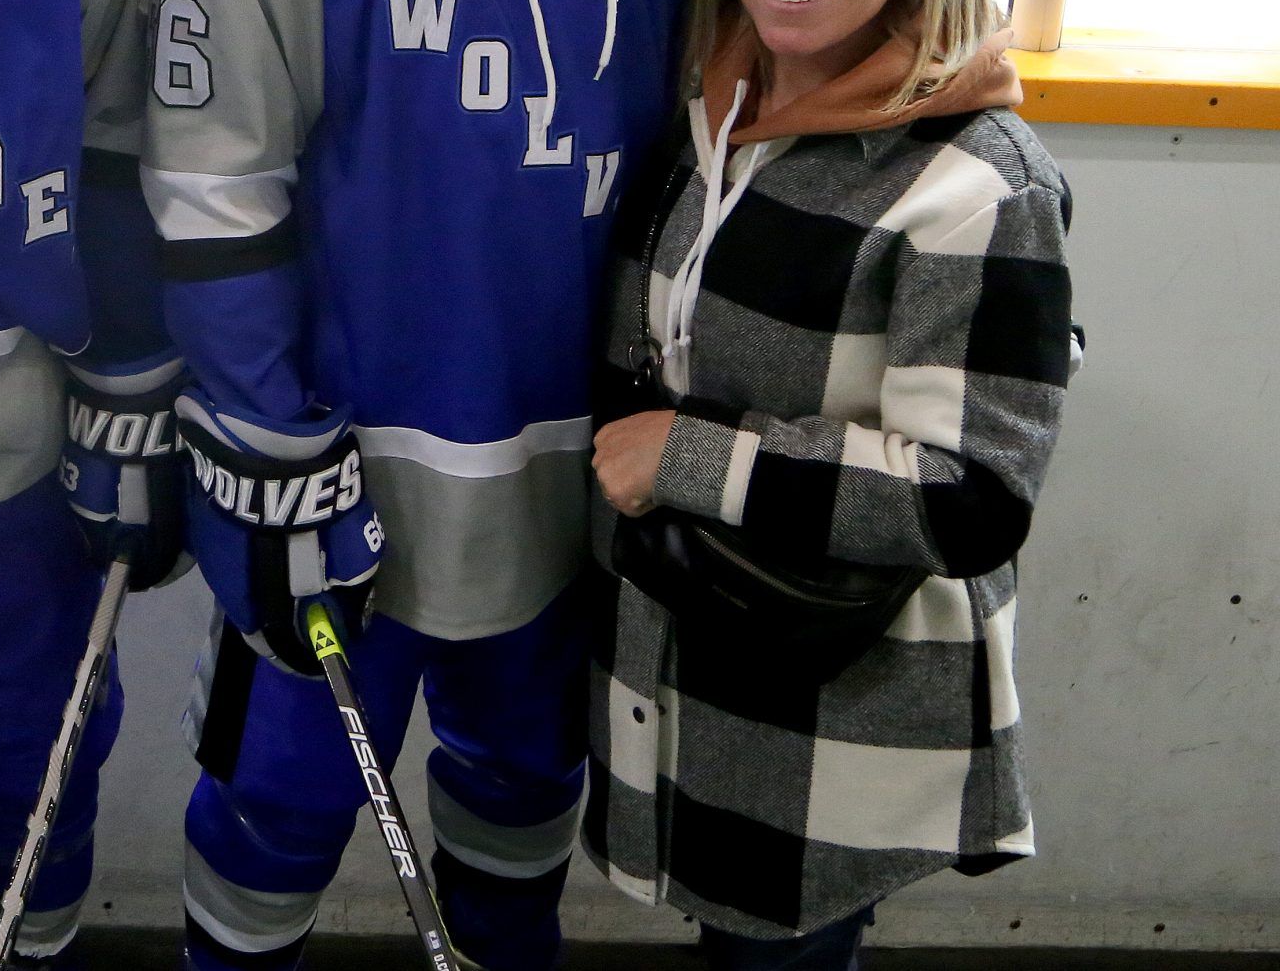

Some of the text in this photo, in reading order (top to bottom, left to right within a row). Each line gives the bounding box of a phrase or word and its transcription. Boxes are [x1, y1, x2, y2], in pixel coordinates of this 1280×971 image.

[69, 396, 186, 458] WOL
[188, 440, 362, 526] WOLVES
[338, 705, 417, 879] FISCHER
